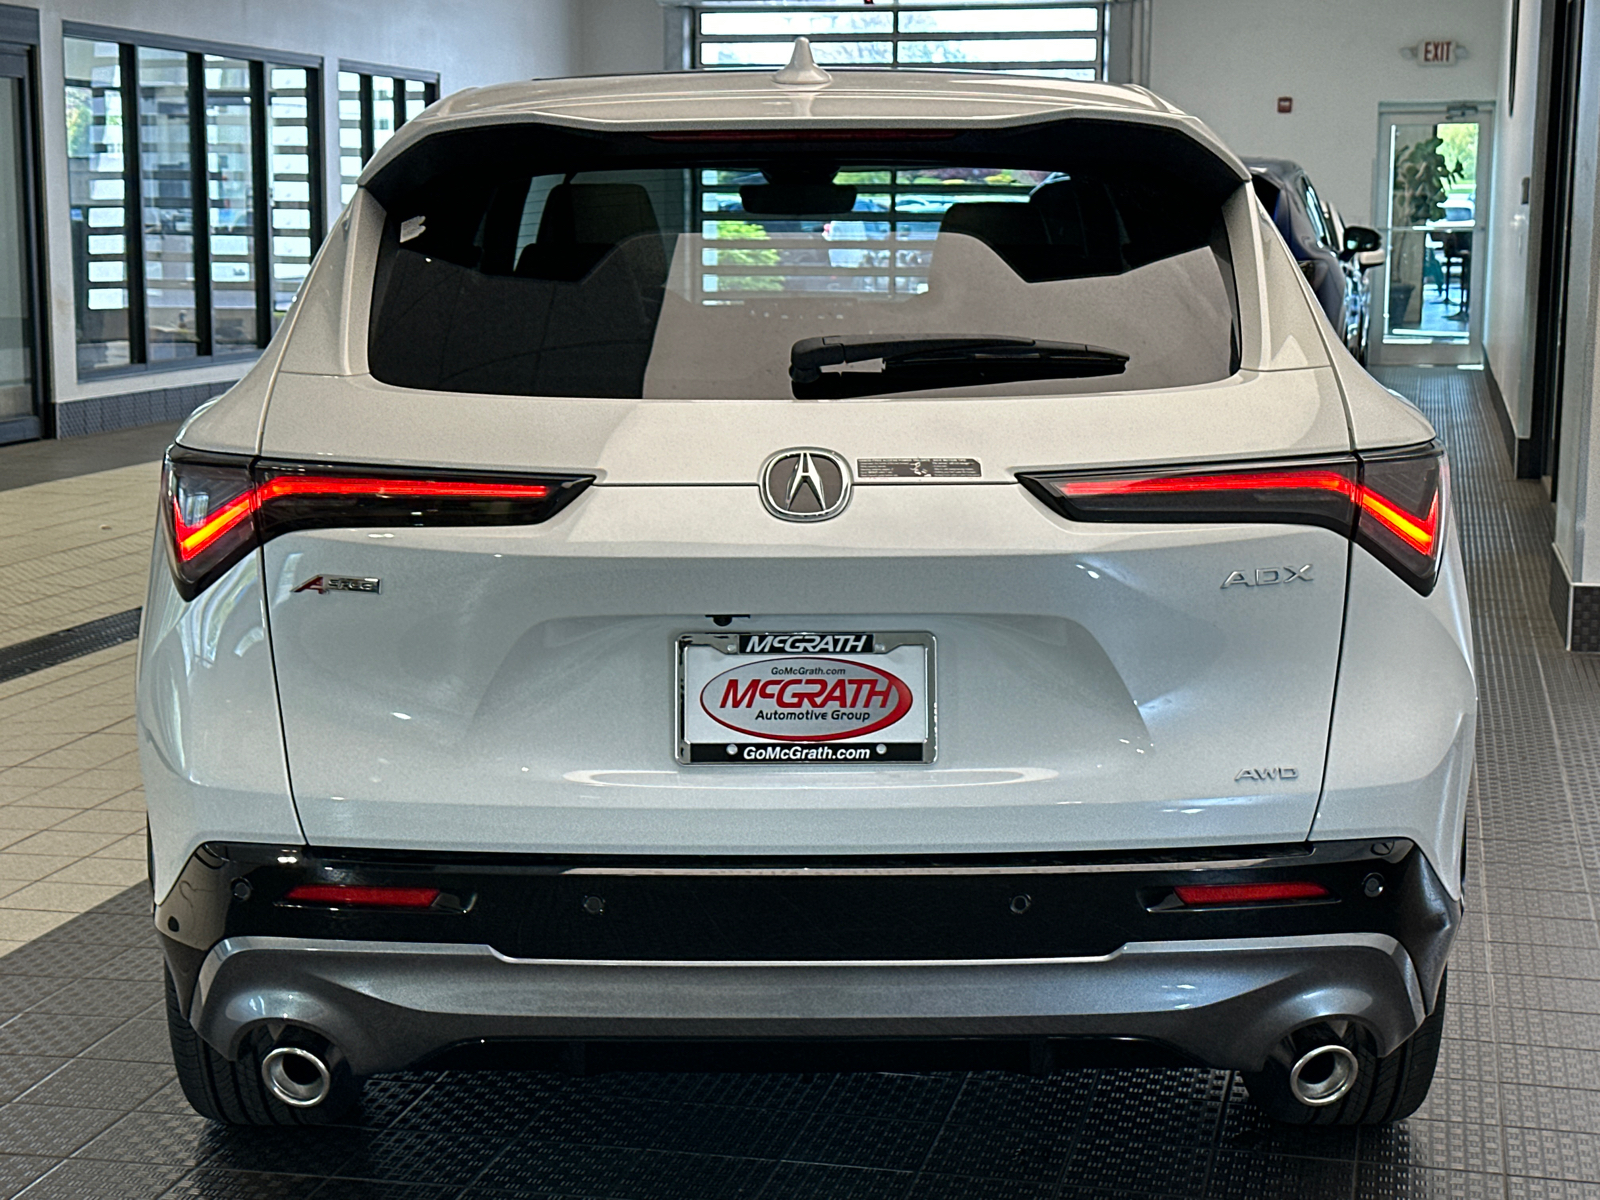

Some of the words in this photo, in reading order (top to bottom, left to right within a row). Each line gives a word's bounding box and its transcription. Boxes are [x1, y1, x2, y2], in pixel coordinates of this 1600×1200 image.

[1424, 41, 1451, 62] EXIT
[1220, 564, 1313, 589] ADX
[771, 667, 846, 676] GoMcGrath.com
[755, 709, 828, 721] Automotive
[830, 709, 870, 722] Group
[743, 746, 870, 760] GoMcGrath.com
[1234, 767, 1299, 782] AWD
